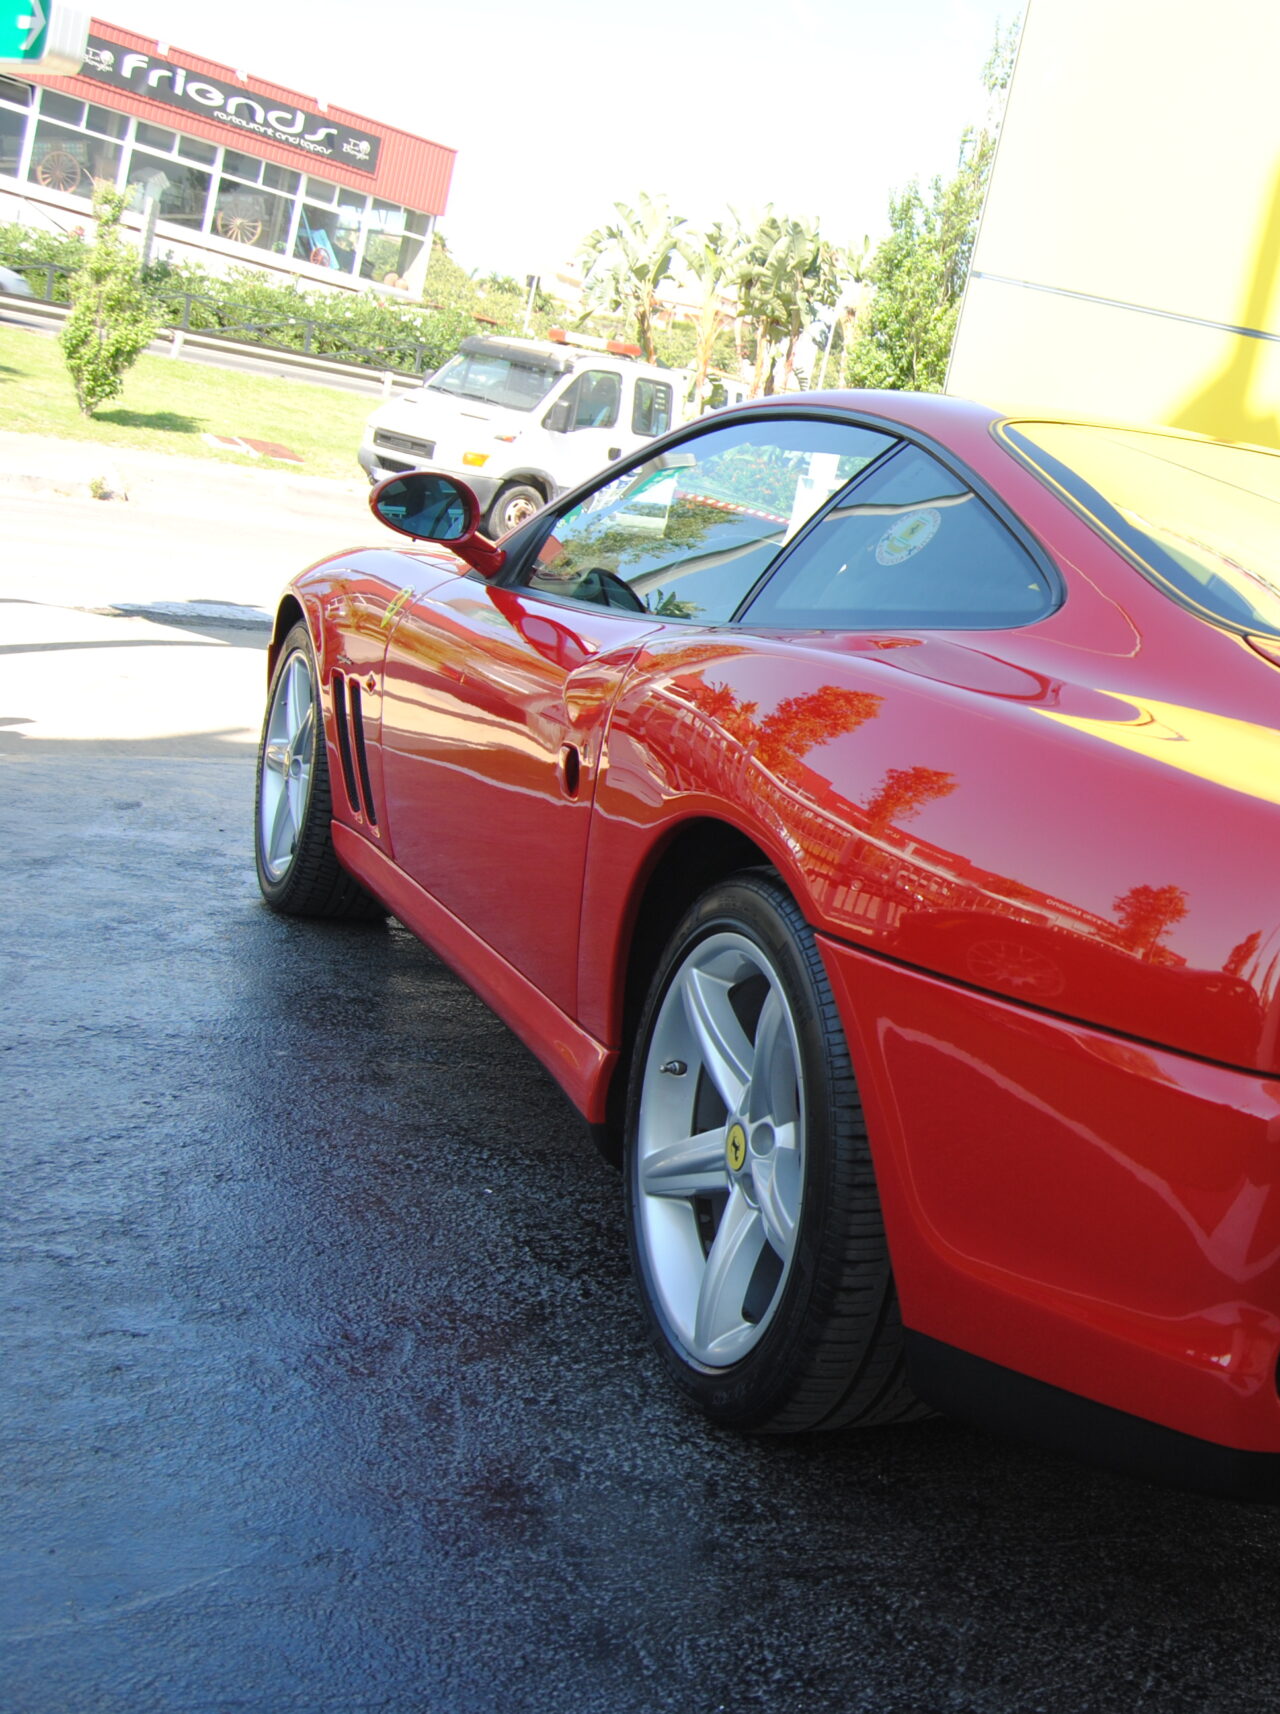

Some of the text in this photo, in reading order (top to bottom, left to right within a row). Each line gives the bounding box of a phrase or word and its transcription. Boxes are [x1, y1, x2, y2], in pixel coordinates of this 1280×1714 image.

[121, 53, 338, 142] friends
[213, 110, 274, 137] restaurant
[275, 131, 299, 145] and
[300, 138, 333, 156] tapas
